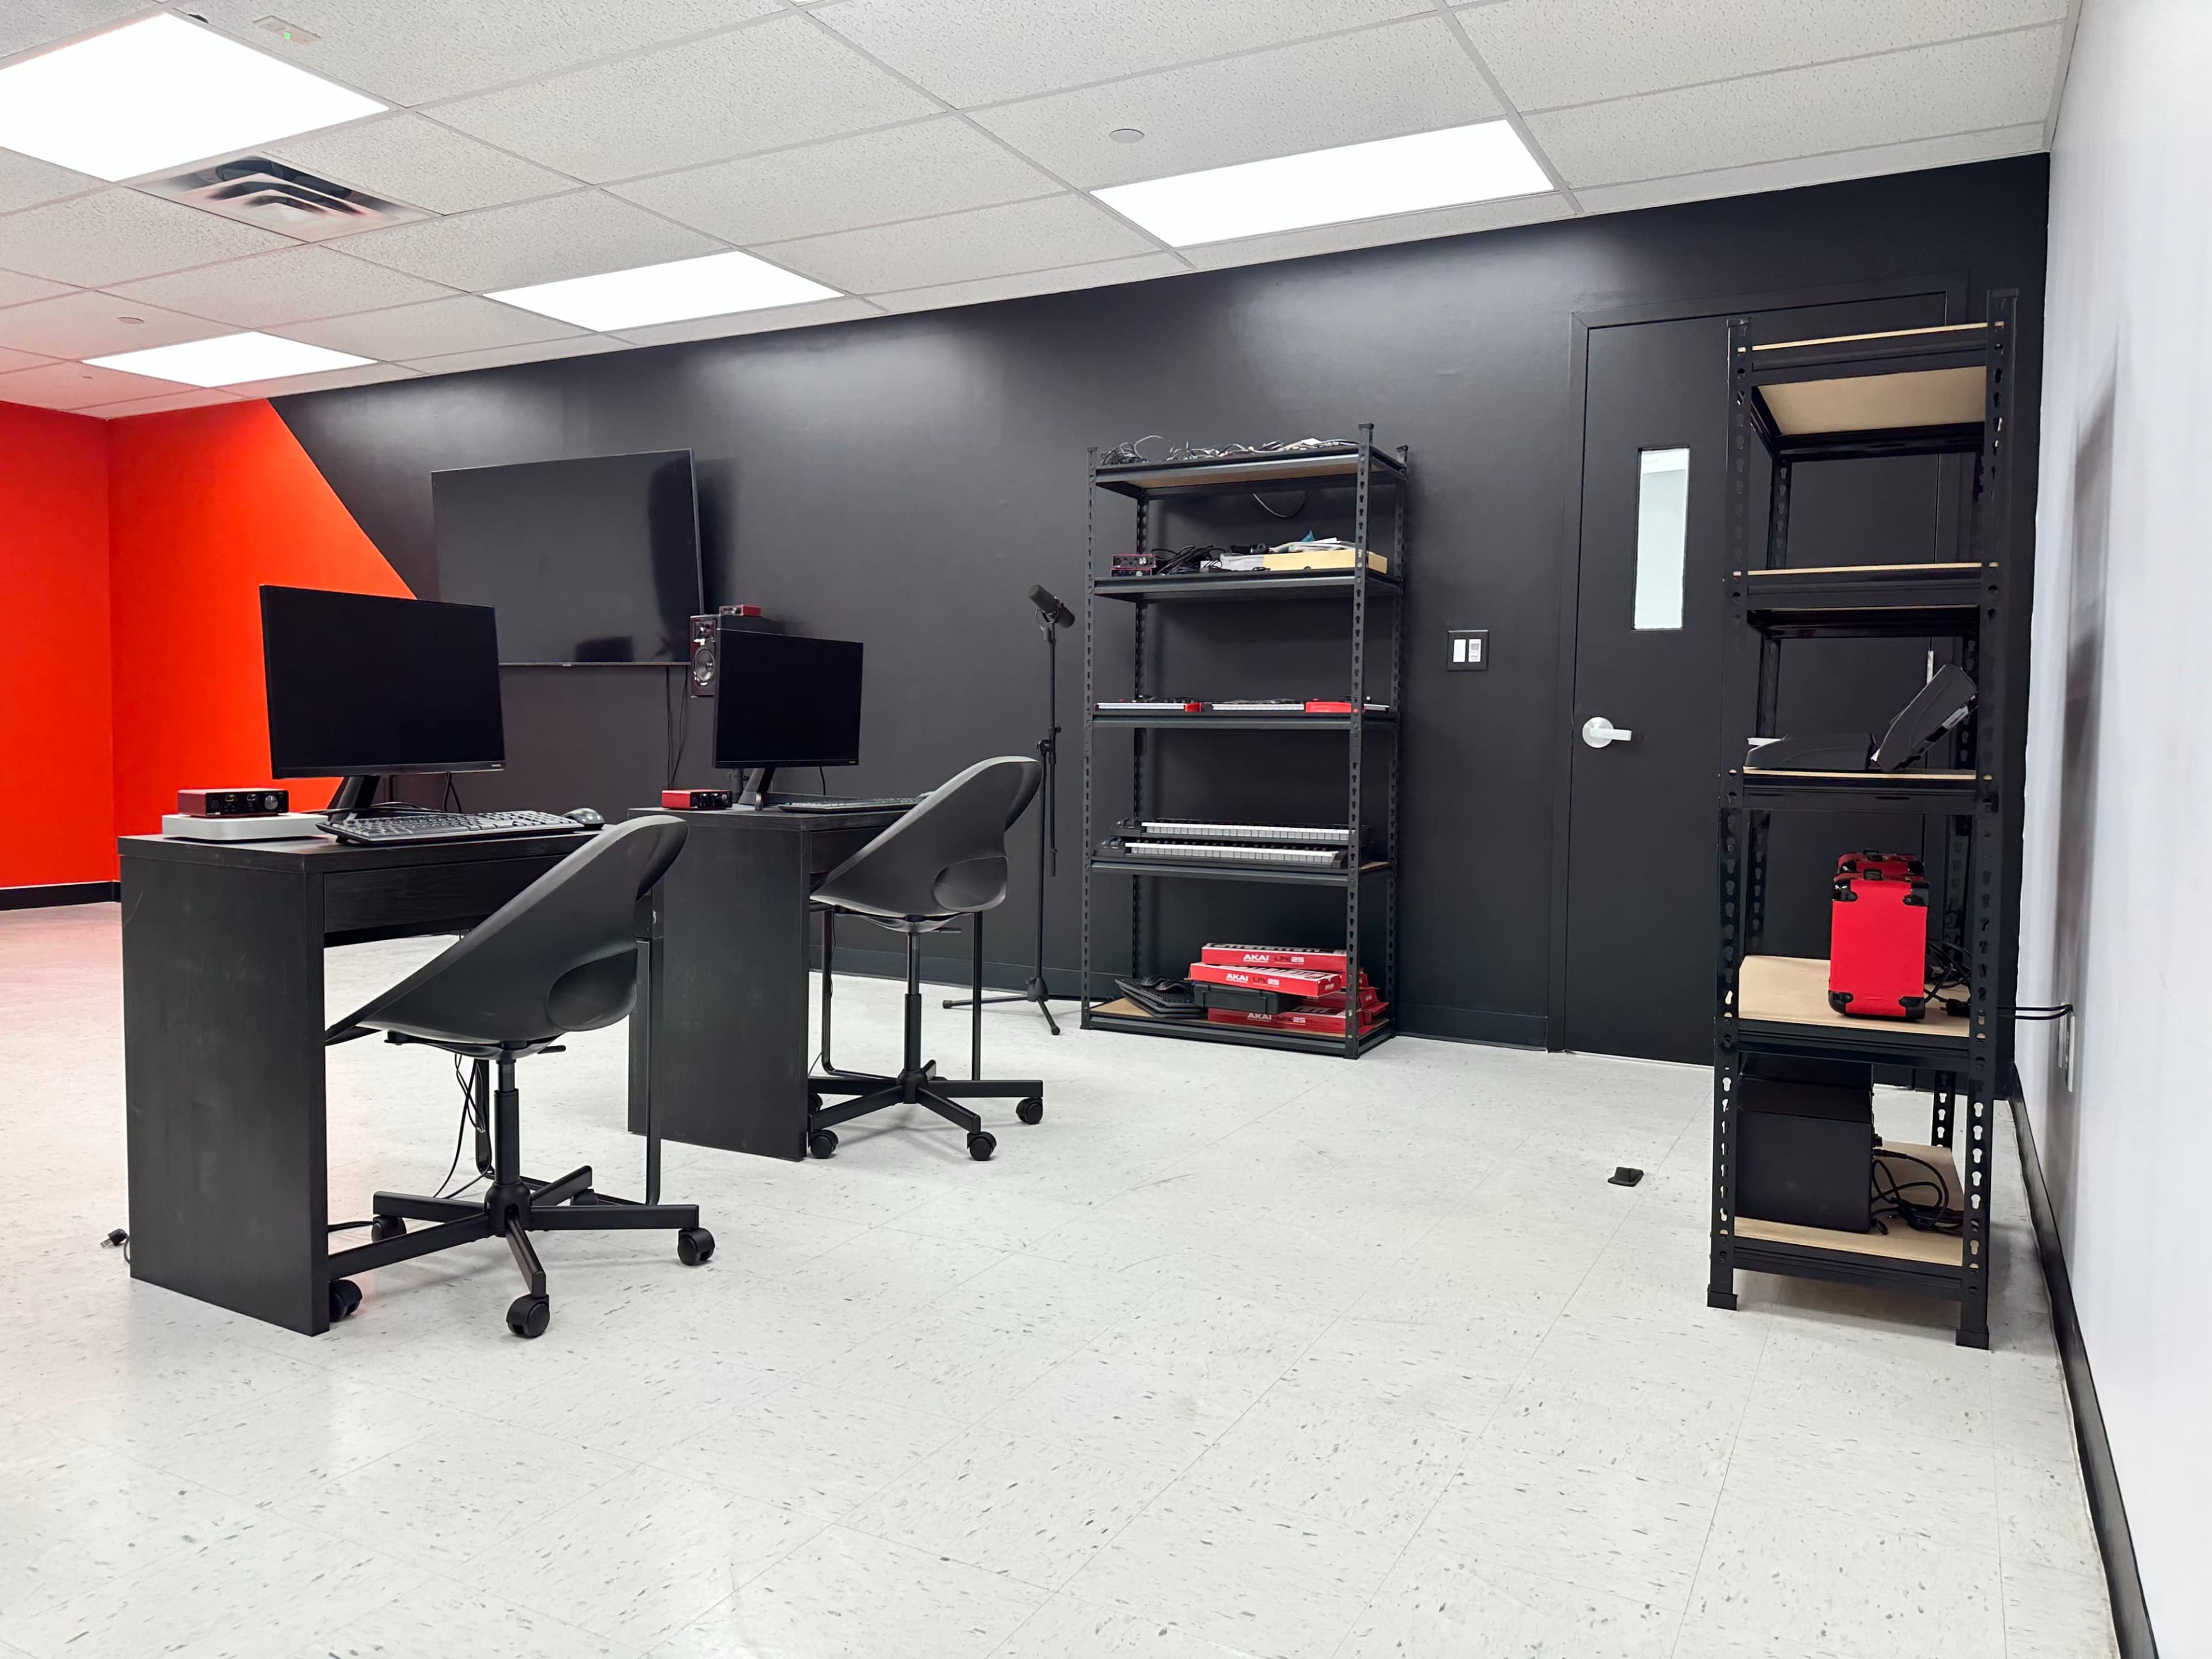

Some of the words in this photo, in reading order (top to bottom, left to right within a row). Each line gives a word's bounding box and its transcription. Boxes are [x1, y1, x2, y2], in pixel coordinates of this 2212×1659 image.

[1275, 955, 1305, 963] LPK25
[1226, 972, 1249, 982] AKAI
[1253, 976, 1280, 986] LPK25
